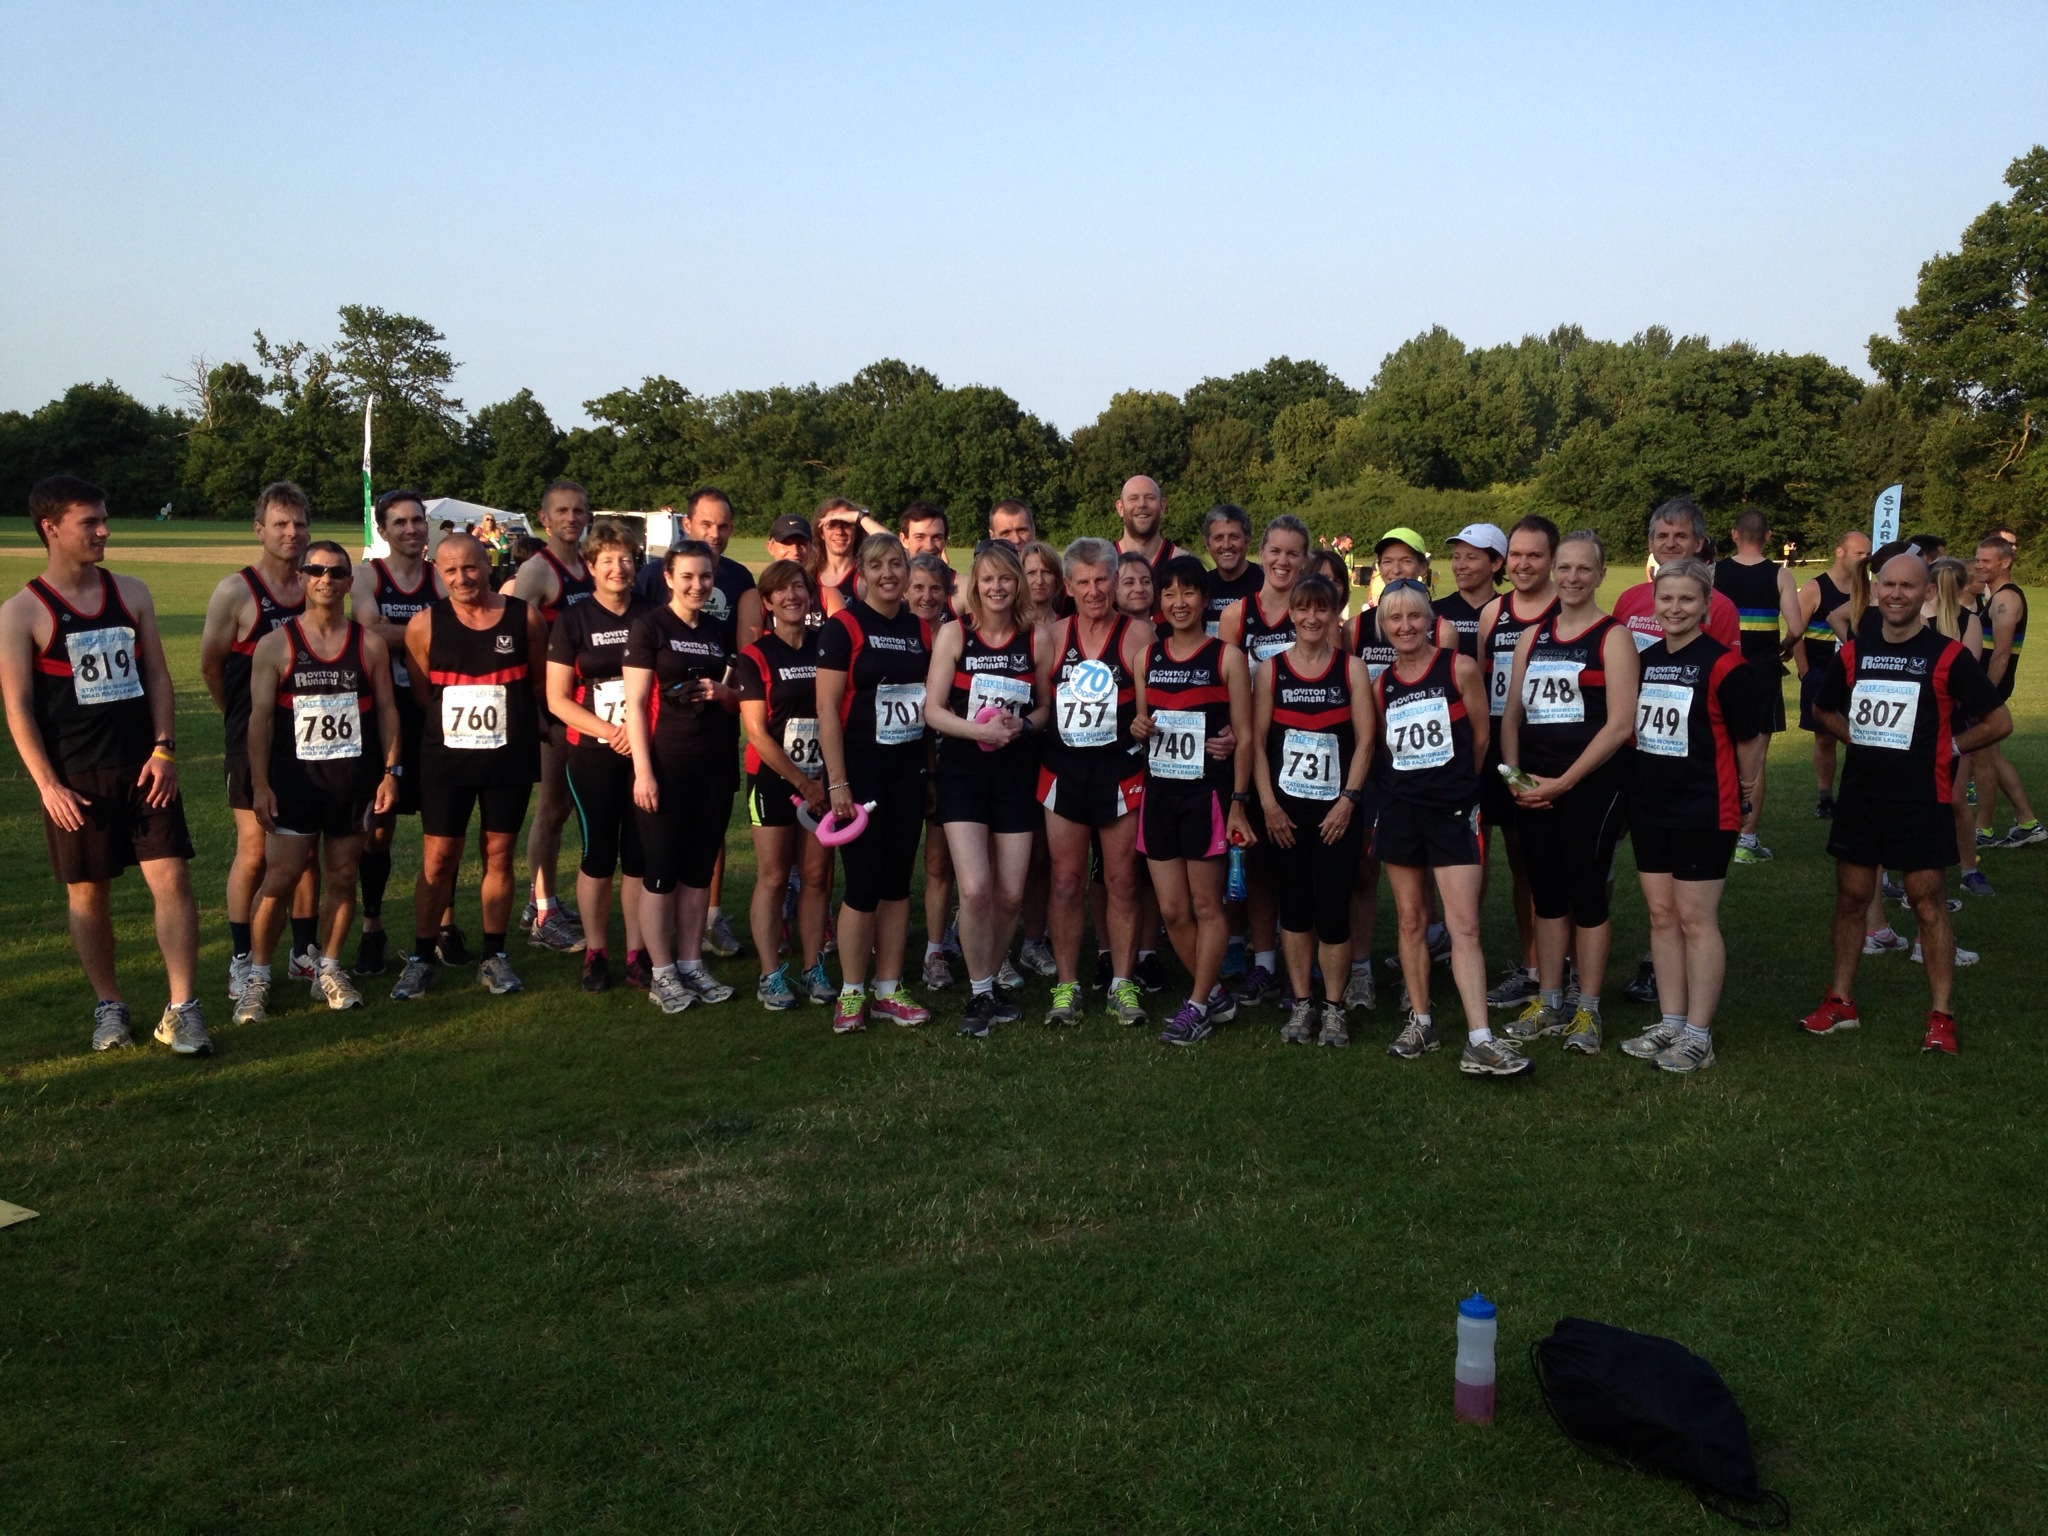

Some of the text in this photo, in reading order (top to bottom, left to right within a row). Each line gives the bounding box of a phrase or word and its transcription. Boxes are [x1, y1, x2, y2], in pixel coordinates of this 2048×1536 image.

[1880, 495, 1894, 544] STAR
[381, 603, 422, 612] ROYSTON
[81, 649, 130, 682] 819
[966, 655, 1008, 663] ROYSTON
[966, 662, 1008, 670] RUNNERS
[1644, 666, 1682, 674] ROYSTON
[1861, 656, 1907, 665] ROYSTON
[1861, 662, 1905, 671] RUNNERS
[294, 670, 339, 679] ROYSTON
[295, 678, 338, 687] RUNNERS
[1077, 663, 1109, 692] 70
[1148, 676, 1188, 684] RUNNERS
[1149, 669, 1190, 678] ROYSTON
[1643, 672, 1679, 680] RUNNERS
[1282, 688, 1326, 696] ROYSTON
[1282, 694, 1325, 703] RUNNERS
[1529, 678, 1575, 705] 748
[451, 705, 497, 731] 760
[882, 701, 919, 726] 701
[1064, 702, 1109, 728] 757
[1639, 705, 1680, 736] 749
[1856, 699, 1907, 728] 807
[303, 714, 352, 742] 786
[1394, 720, 1444, 752] 708
[790, 738, 820, 763] 82
[1153, 732, 1195, 760] 740
[1288, 751, 1330, 782] 731
